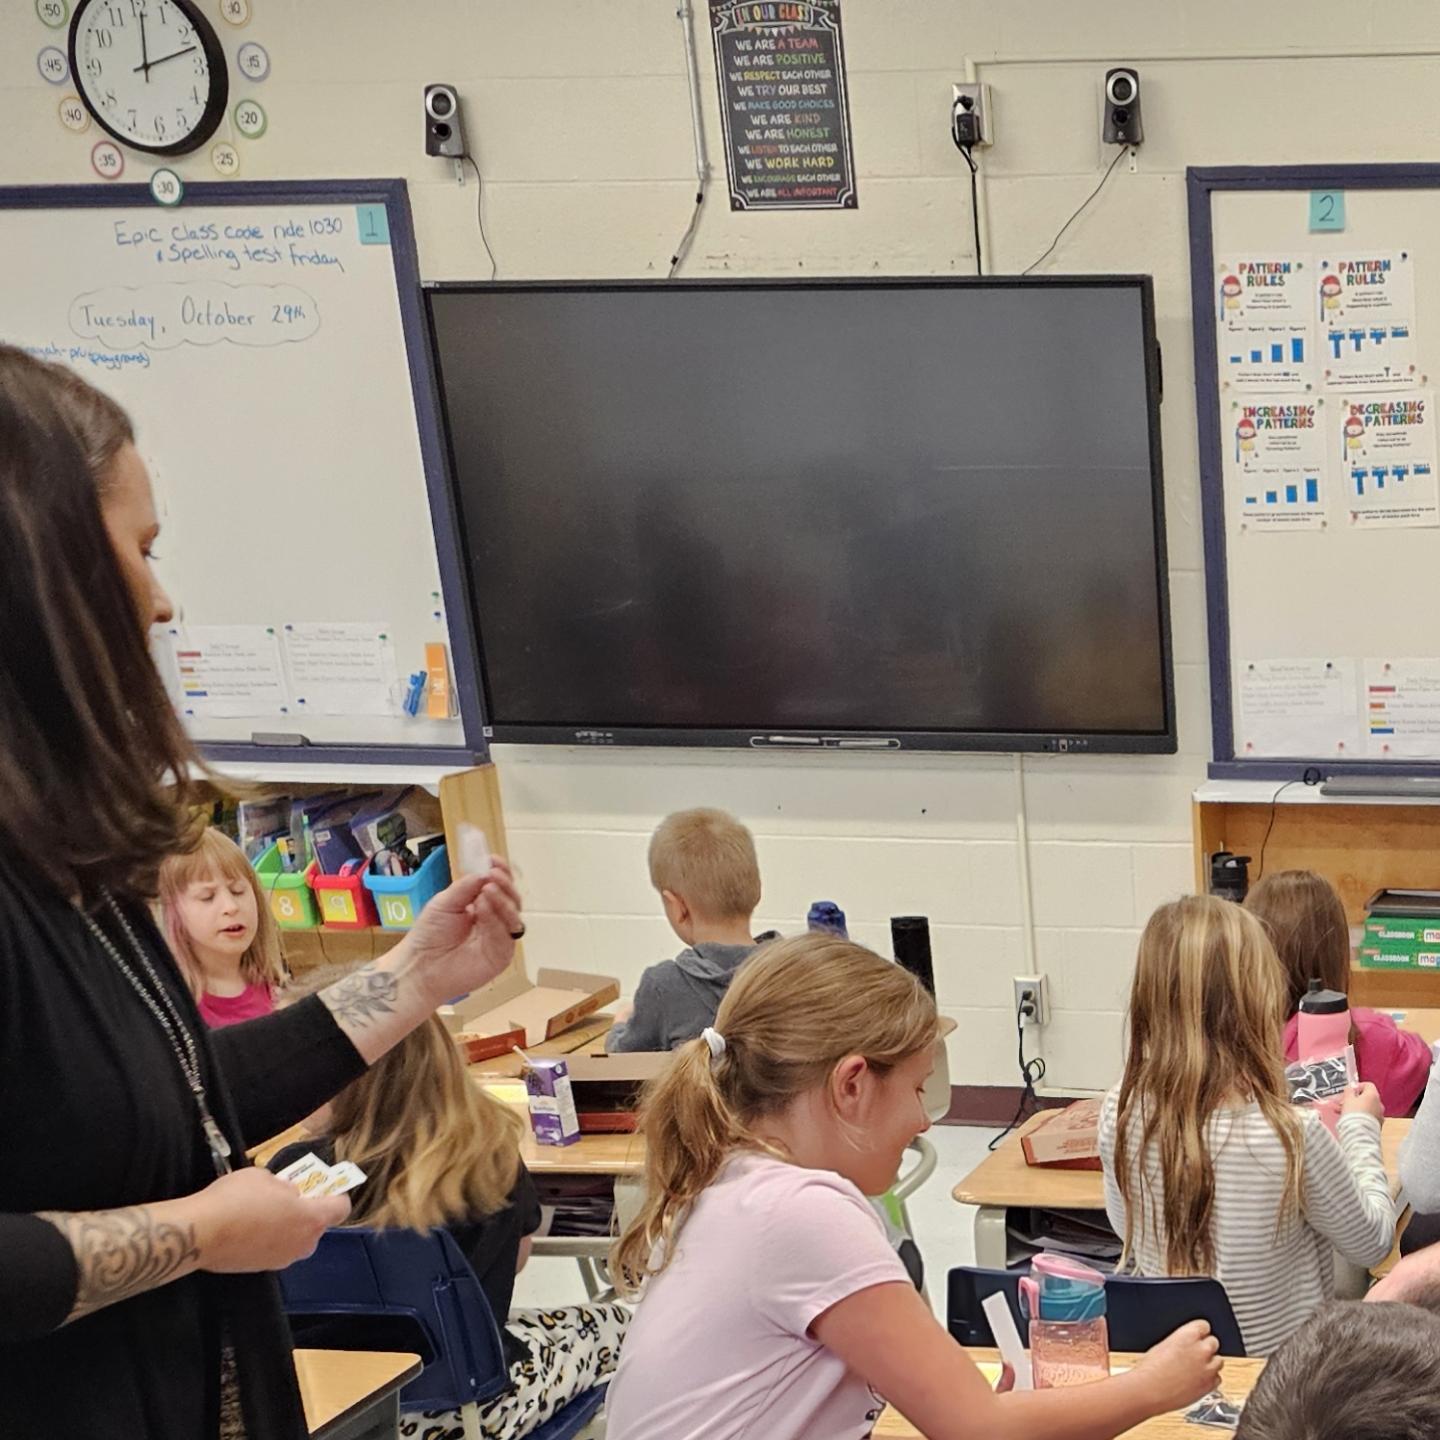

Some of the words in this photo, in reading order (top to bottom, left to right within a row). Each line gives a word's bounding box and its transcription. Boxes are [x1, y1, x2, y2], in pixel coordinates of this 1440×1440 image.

[109, 7, 124, 26] 11
[159, 6, 166, 24] 1
[753, 4, 775, 20] OUR
[779, 3, 809, 21] CLASS
[96, 29, 112, 48] 10
[178, 28, 190, 45] 2
[736, 40, 752, 50] WE
[755, 39, 776, 49] ARE
[778, 39, 785, 48] A
[790, 38, 819, 48] TEAM
[734, 56, 750, 66] WE
[753, 55, 774, 66] ARE
[776, 54, 826, 65] POSITIVE
[91, 59, 102, 77] 9
[730, 73, 742, 81] WE
[744, 71, 780, 81] RESPECT
[782, 71, 803, 79] EACH
[804, 70, 832, 79] OTHER
[738, 86, 754, 96] WE
[756, 86, 776, 96] TRY
[779, 85, 800, 96] OUR
[802, 84, 827, 95] BEST
[734, 102, 746, 110] WE
[748, 101, 771, 110] MAKE
[773, 100, 797, 109] GOOD
[799, 100, 834, 109] CHOICES
[128, 110, 137, 129] 7
[154, 116, 165, 134] 6
[751, 115, 767, 125] WE
[770, 115, 791, 124] ARE
[794, 114, 821, 124] KIND
[746, 130, 762, 140] WE
[764, 129, 784, 139] ARE
[787, 128, 831, 139] HONEST
[738, 146, 750, 154] WE
[779, 145, 789, 153] TO
[791, 144, 810, 153] EACH
[812, 144, 837, 152] OTHER
[745, 159, 762, 169] WE
[766, 158, 799, 168] WORK
[803, 157, 834, 168] HARD
[797, 174, 816, 182] EACH
[817, 174, 840, 182] OTHER
[1319, 195, 1335, 222] 2
[309, 217, 342, 235] 1030
[365, 212, 378, 236] 1
[167, 245, 241, 270] Spelling
[243, 244, 282, 262] test
[289, 244, 344, 272] Friday
[1239, 263, 1291, 274] PATTERN
[1338, 260, 1391, 273] PATTERN
[1247, 275, 1285, 287] RULES
[1347, 273, 1385, 286] RULES
[181, 296, 255, 327] October
[1243, 405, 1314, 417] INCREASING
[1350, 401, 1424, 416] DECREASING
[1257, 417, 1314, 429] PATTERNS
[1365, 413, 1423, 427] PATTERNS
[279, 896, 294, 916] 8
[330, 896, 348, 915] 9
[385, 901, 406, 921] 10
